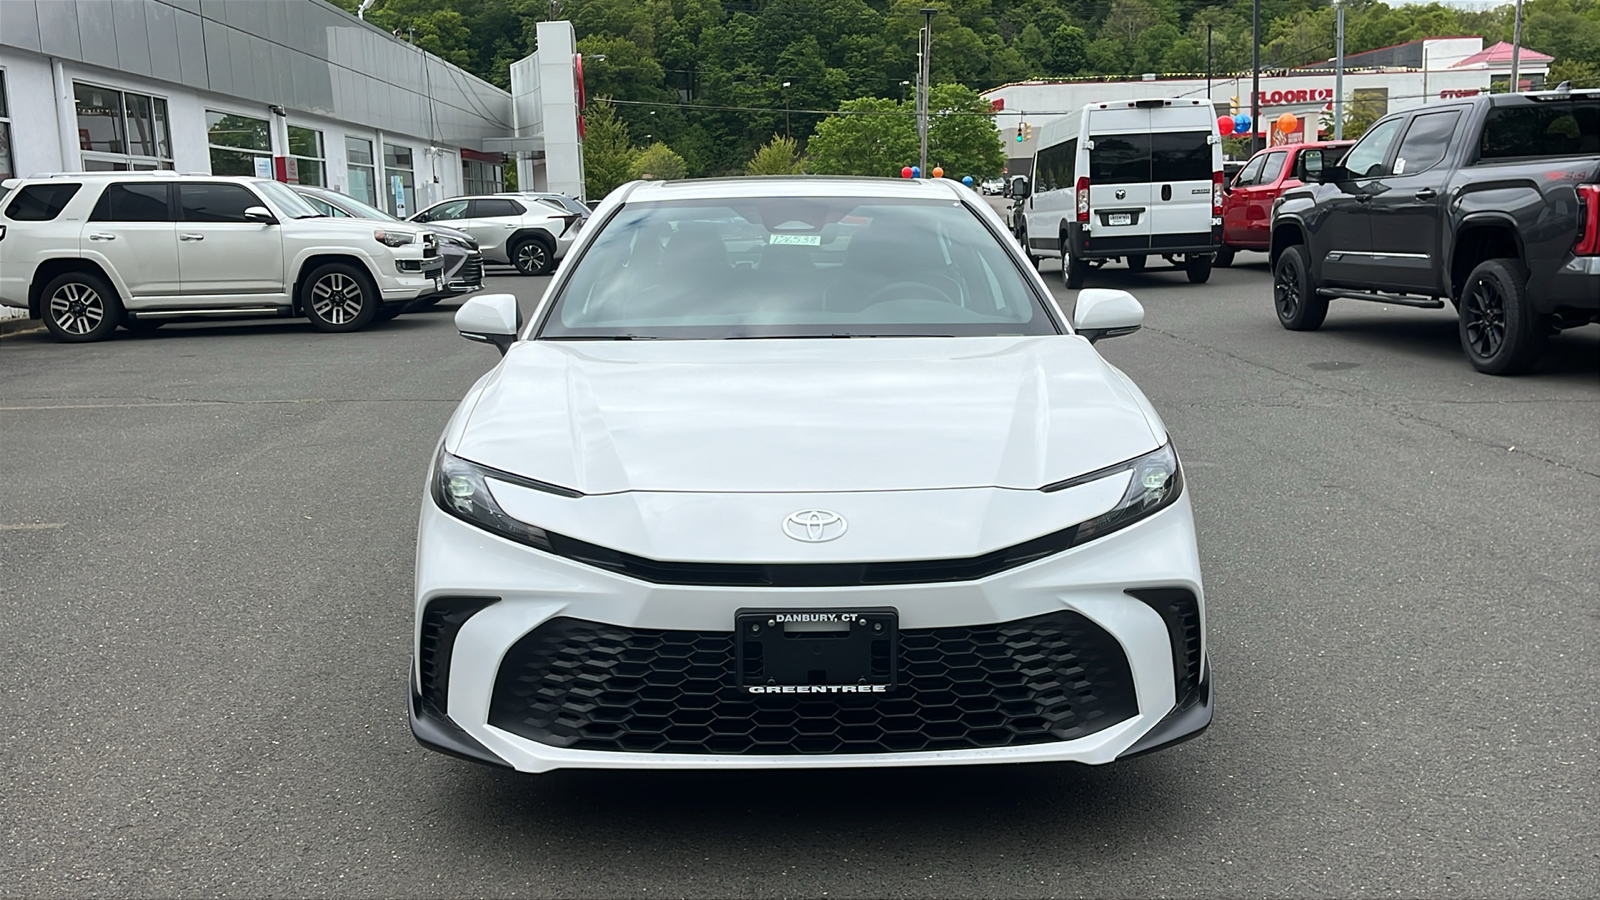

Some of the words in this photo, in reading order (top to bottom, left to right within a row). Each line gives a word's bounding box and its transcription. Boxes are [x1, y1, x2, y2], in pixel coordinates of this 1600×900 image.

[776, 614, 838, 622] DANBURY,
[841, 613, 858, 622] CT
[748, 685, 886, 693] GREENTREE
